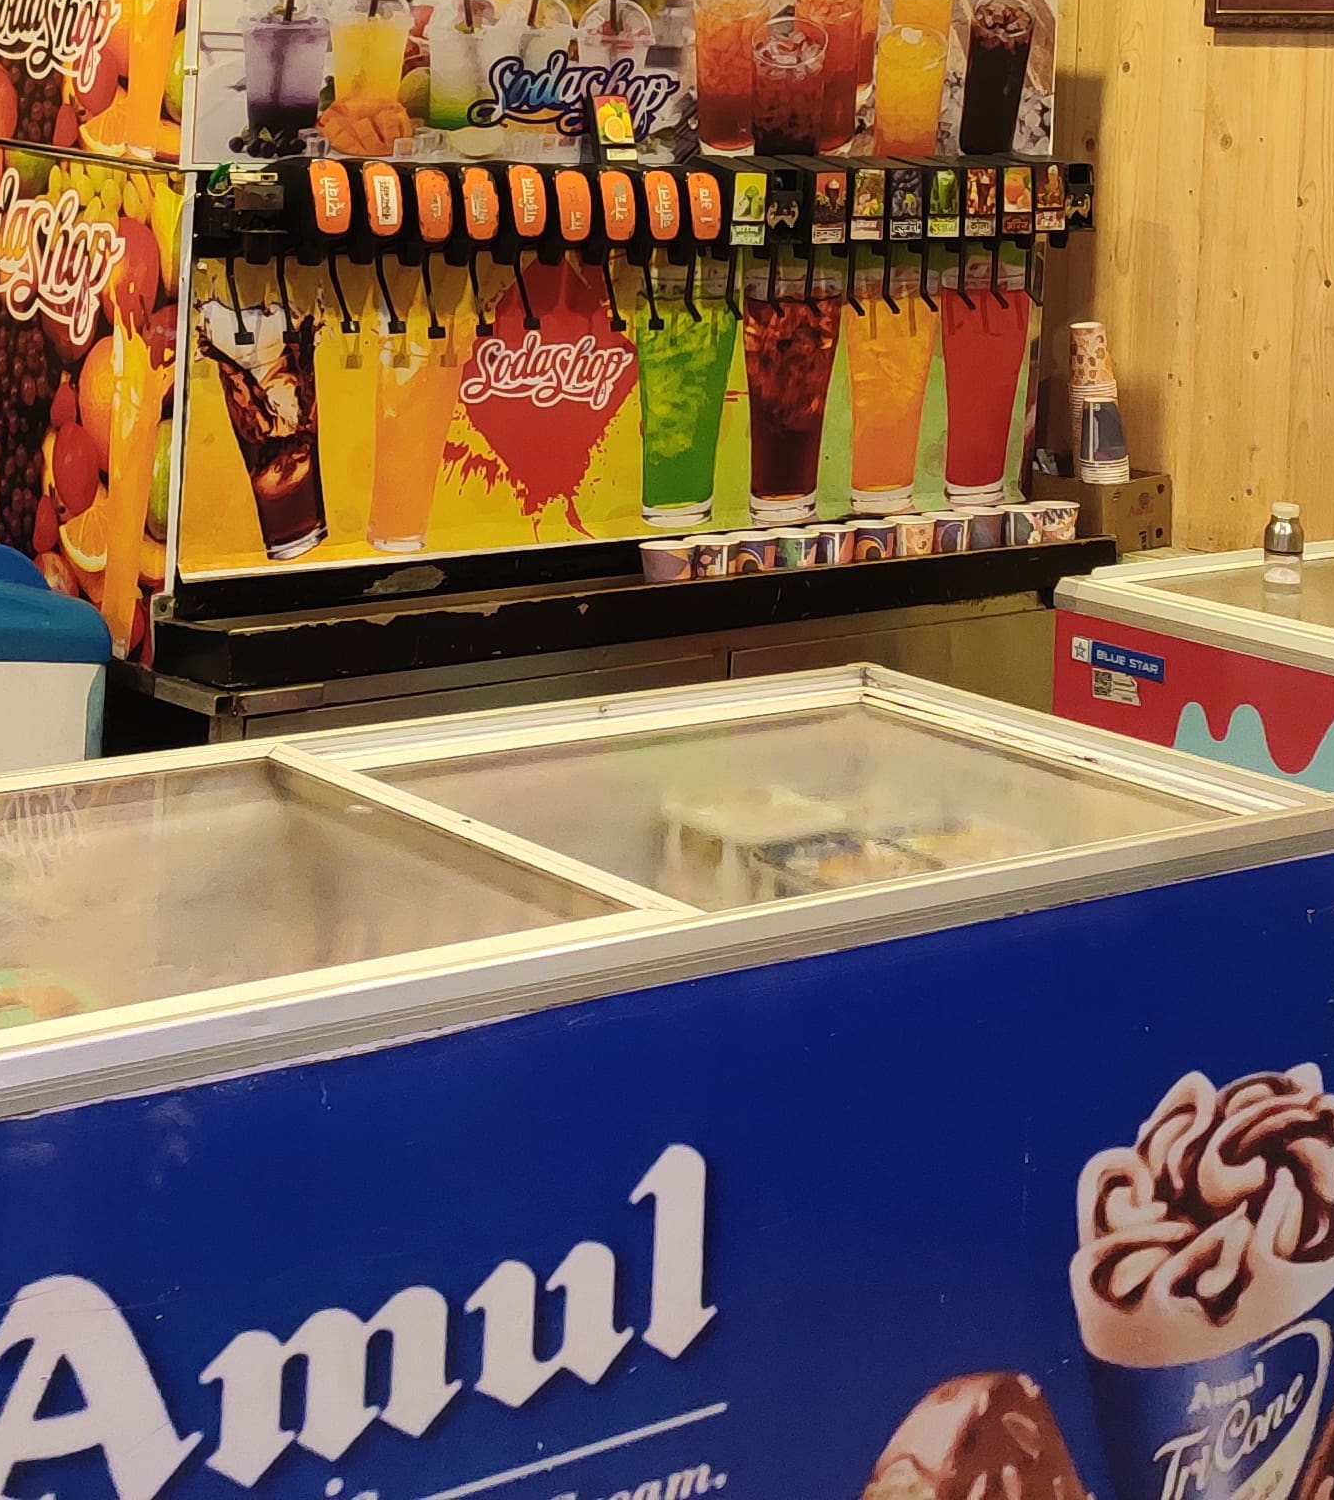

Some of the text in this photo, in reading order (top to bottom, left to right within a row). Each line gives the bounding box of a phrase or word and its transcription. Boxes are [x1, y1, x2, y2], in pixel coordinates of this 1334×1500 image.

[1096, 649, 1158, 674] BLUE STAR
[1188, 1361, 1264, 1414] Amul
